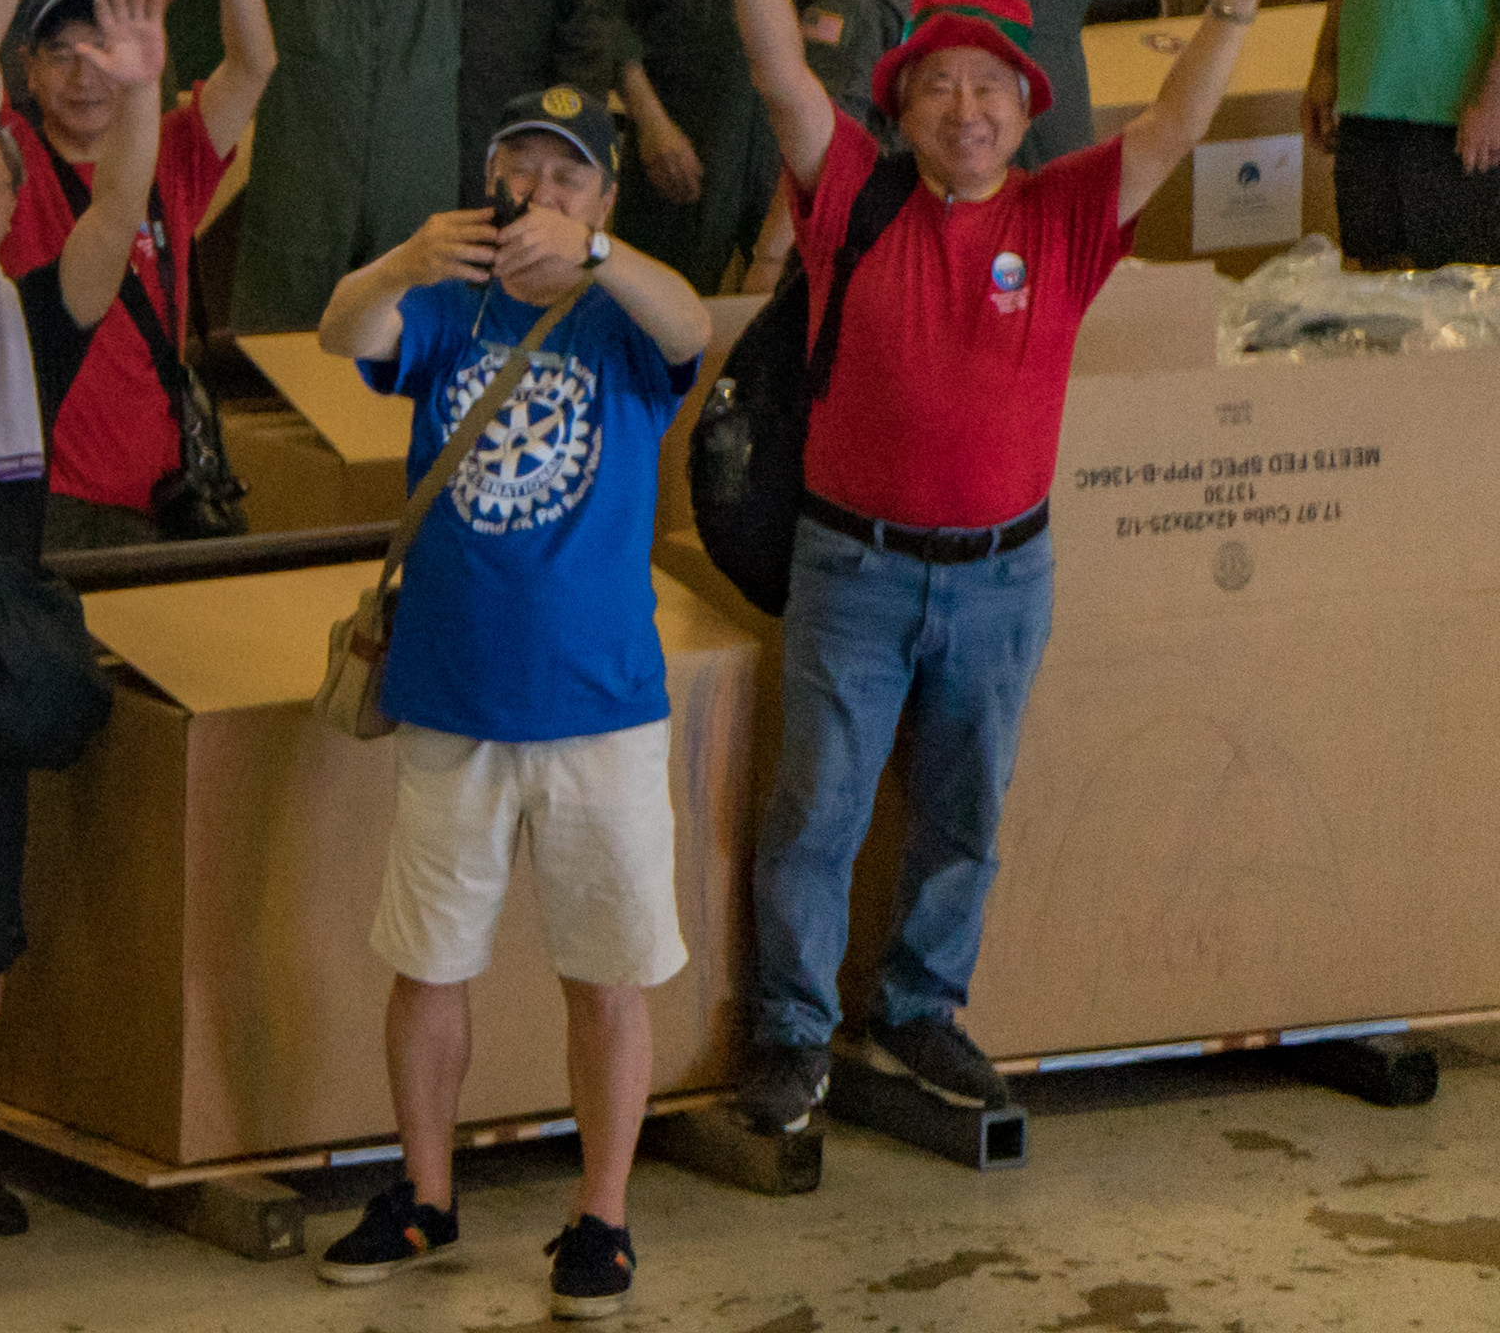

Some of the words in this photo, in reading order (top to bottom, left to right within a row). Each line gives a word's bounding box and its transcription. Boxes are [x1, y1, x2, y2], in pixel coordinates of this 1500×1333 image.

[1210, 454, 1263, 478] SPEC
[1269, 451, 1308, 474] FED
[1313, 445, 1381, 471] MEETS
[1074, 459, 1205, 490] PPP-B-1364C
[1204, 483, 1255, 504] 13730
[472, 517, 507, 535] and
